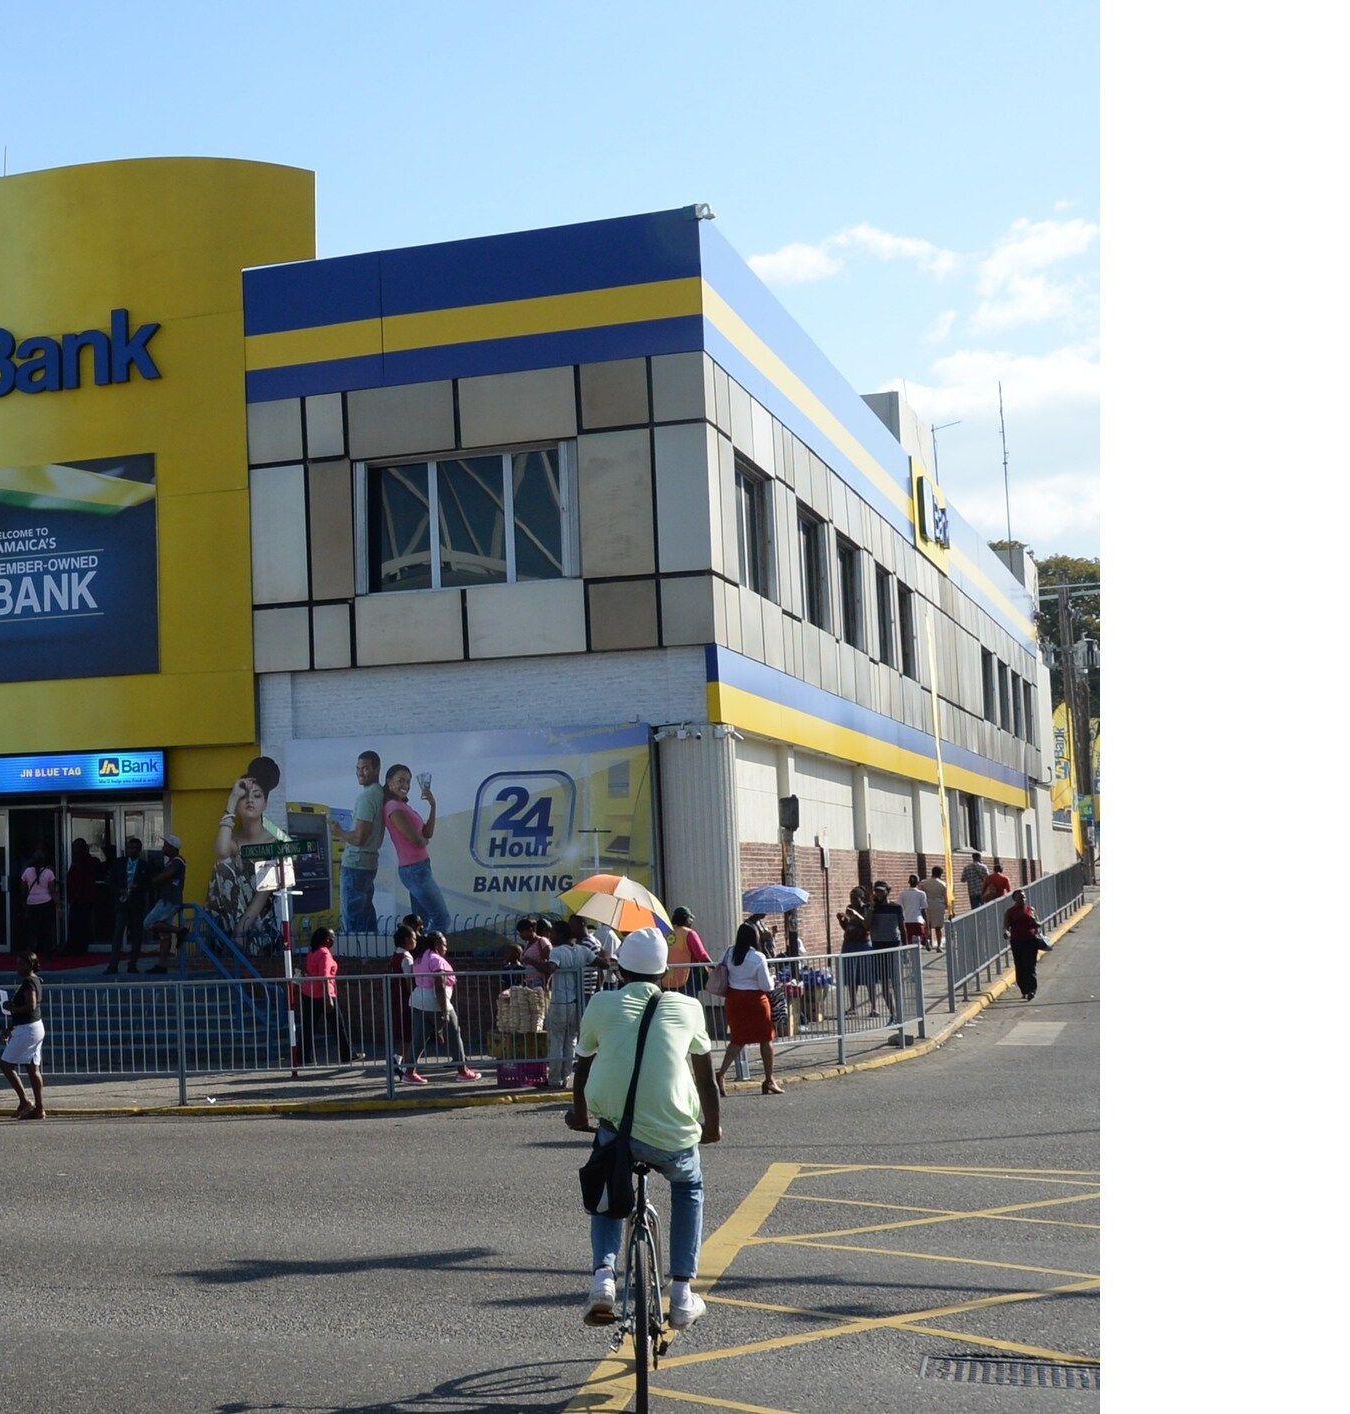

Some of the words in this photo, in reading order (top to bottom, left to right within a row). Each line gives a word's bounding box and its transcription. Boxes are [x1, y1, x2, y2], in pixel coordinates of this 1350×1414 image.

[36, 527, 49, 537] TO
[1054, 727, 1065, 757] Bank
[20, 769, 33, 778] JN
[35, 767, 60, 777] BLUE
[61, 766, 82, 776] TAG
[121, 758, 159, 774] Bank
[491, 786, 554, 846] 24
[241, 844, 274, 858] CONSTANT
[276, 842, 301, 855] SPRING
[306, 841, 317, 852] RD
[489, 837, 553, 857] Hour
[473, 875, 573, 892] BANKING
